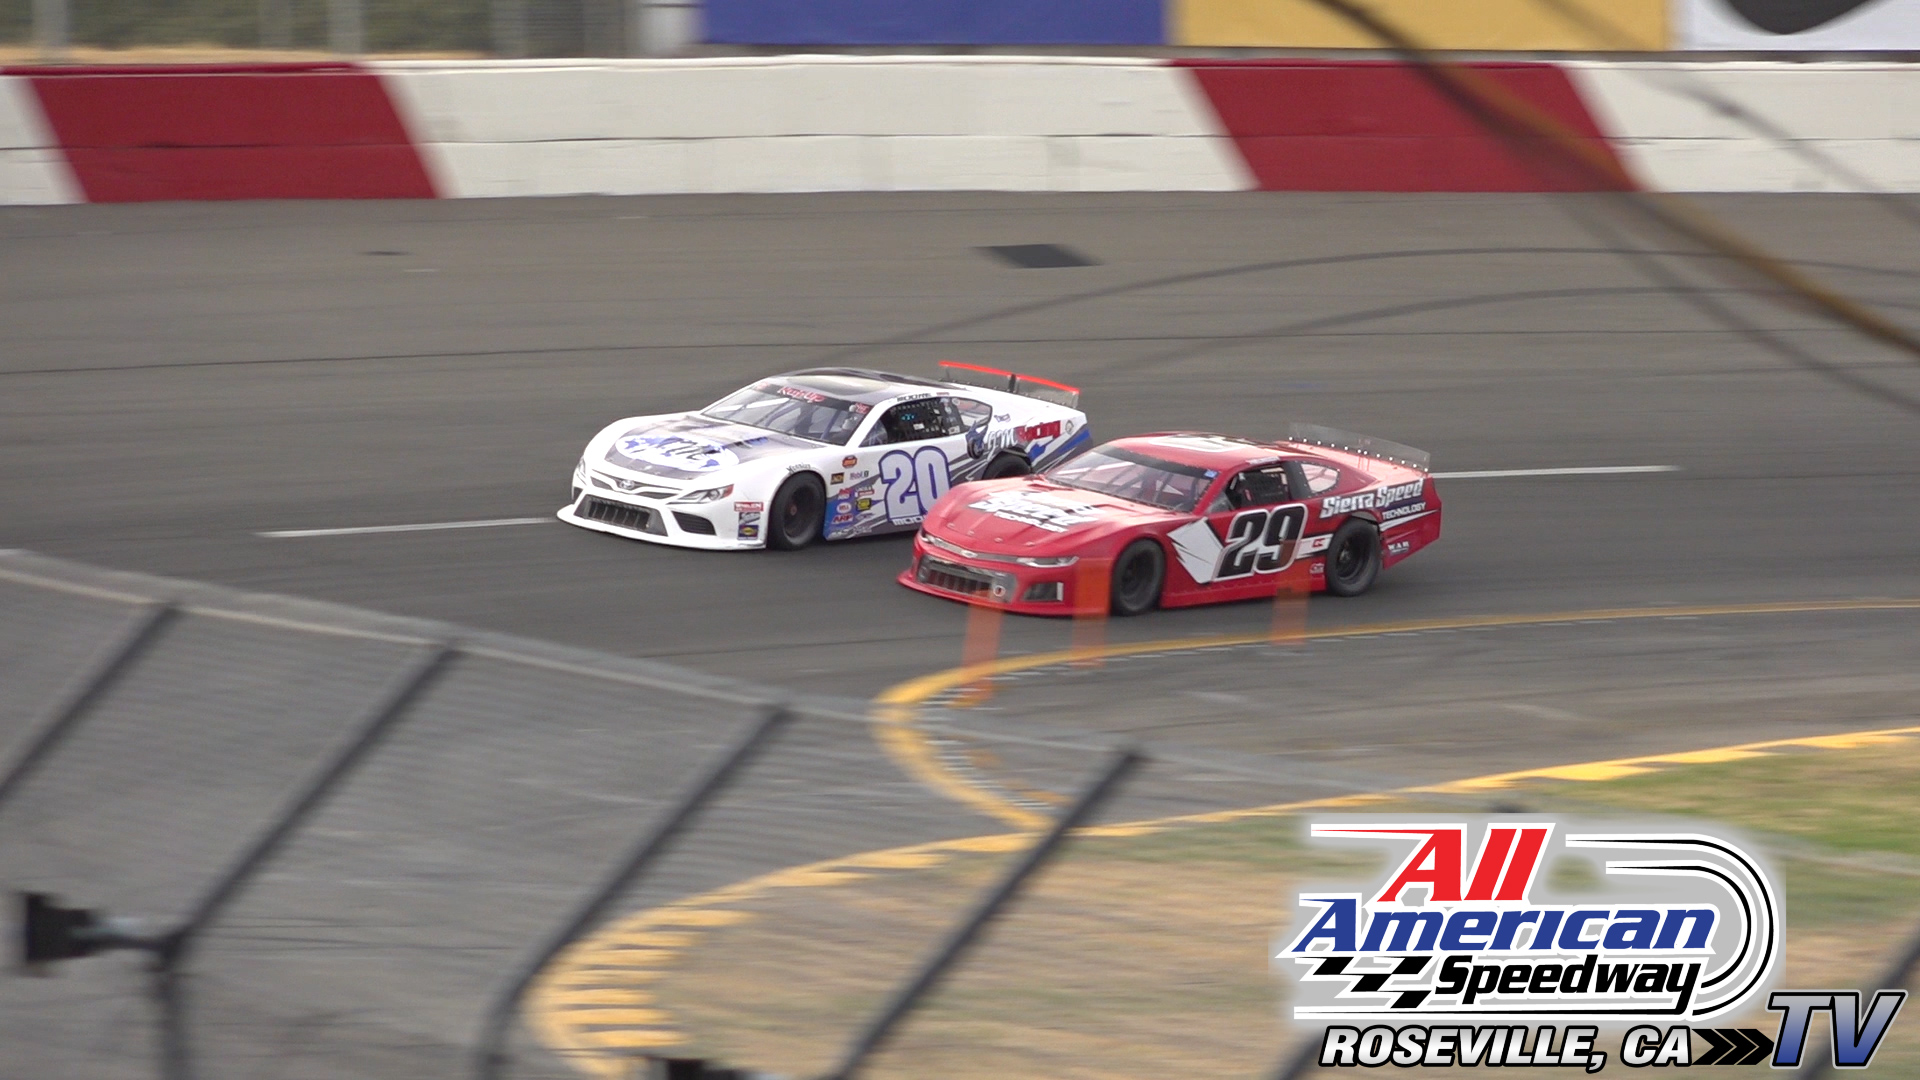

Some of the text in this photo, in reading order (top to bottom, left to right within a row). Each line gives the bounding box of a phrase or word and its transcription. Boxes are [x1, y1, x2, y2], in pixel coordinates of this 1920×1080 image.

[879, 446, 951, 522] 20
[1319, 479, 1425, 519] Sierra Speed
[1382, 502, 1426, 520] TECHNOLOGY
[1214, 503, 1309, 582] 29
